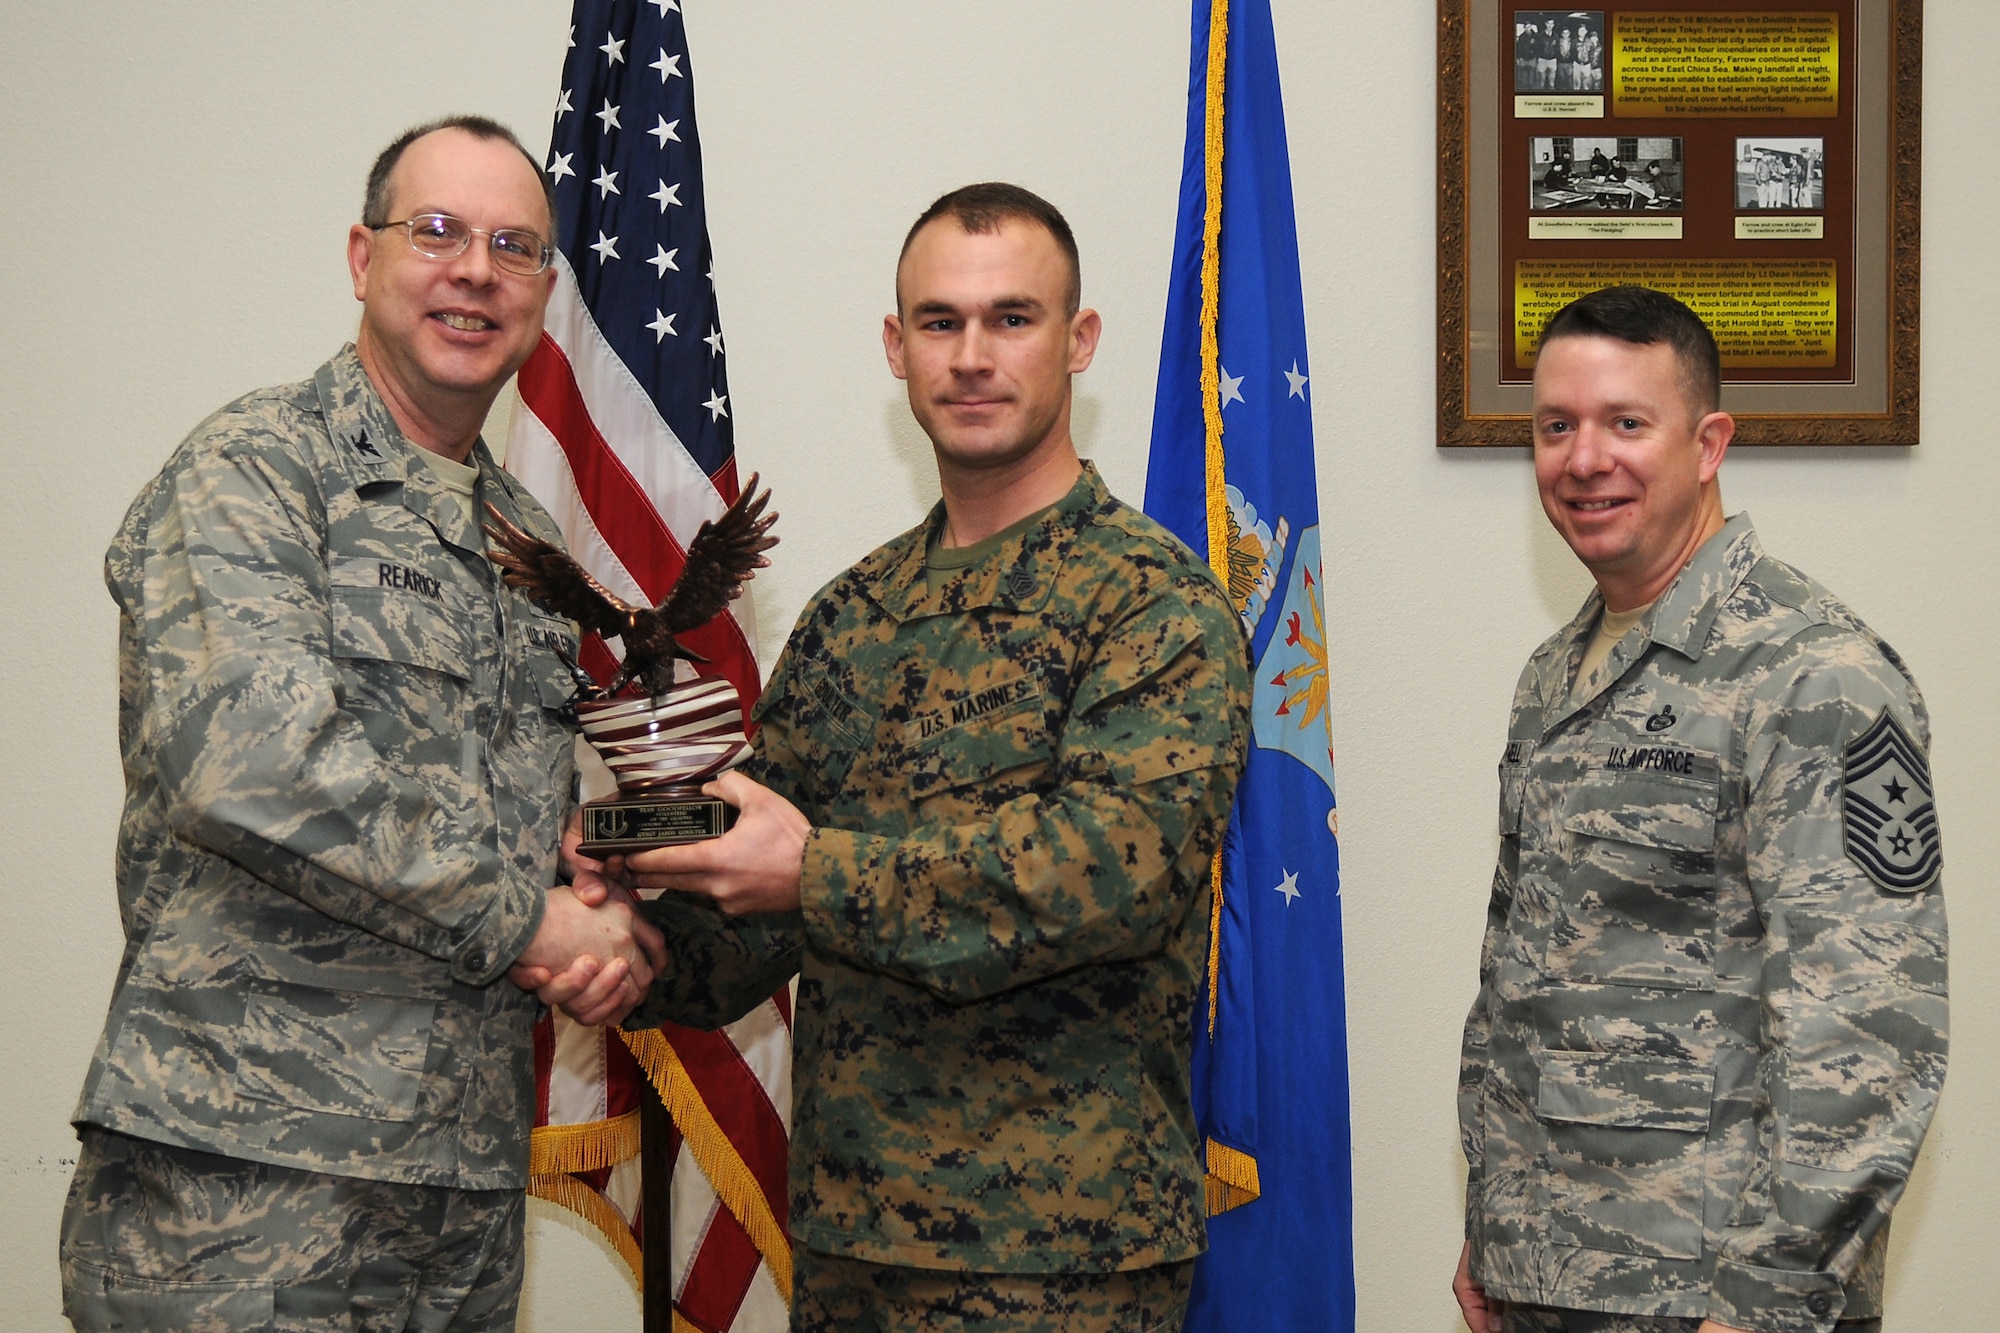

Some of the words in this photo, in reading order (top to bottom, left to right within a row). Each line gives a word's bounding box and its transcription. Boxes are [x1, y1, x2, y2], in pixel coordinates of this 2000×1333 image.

[1730, 36, 1745, 45] city
[1645, 46, 1682, 55] dropping
[1807, 46, 1830, 55] depot
[1733, 66, 1763, 75] Making
[1640, 85, 1669, 94] ground
[1736, 85, 1769, 94] warning
[1771, 85, 1789, 94] light
[1536, 290, 1559, 300] Tokyo
[1678, 290, 1695, 300] they
[1752, 300, 1780, 309] August
[1716, 320, 1730, 329] Sgt
[1762, 320, 1784, 329] Spatz
[1795, 320, 1812, 329] they
[380, 562, 444, 602] REARICK
[920, 714, 948, 738] U.S.
[952, 680, 1026, 724] MARINES
[1608, 747, 1624, 768] U.S.
[1627, 748, 1648, 768] AIR
[1648, 748, 1695, 774] FORCE
